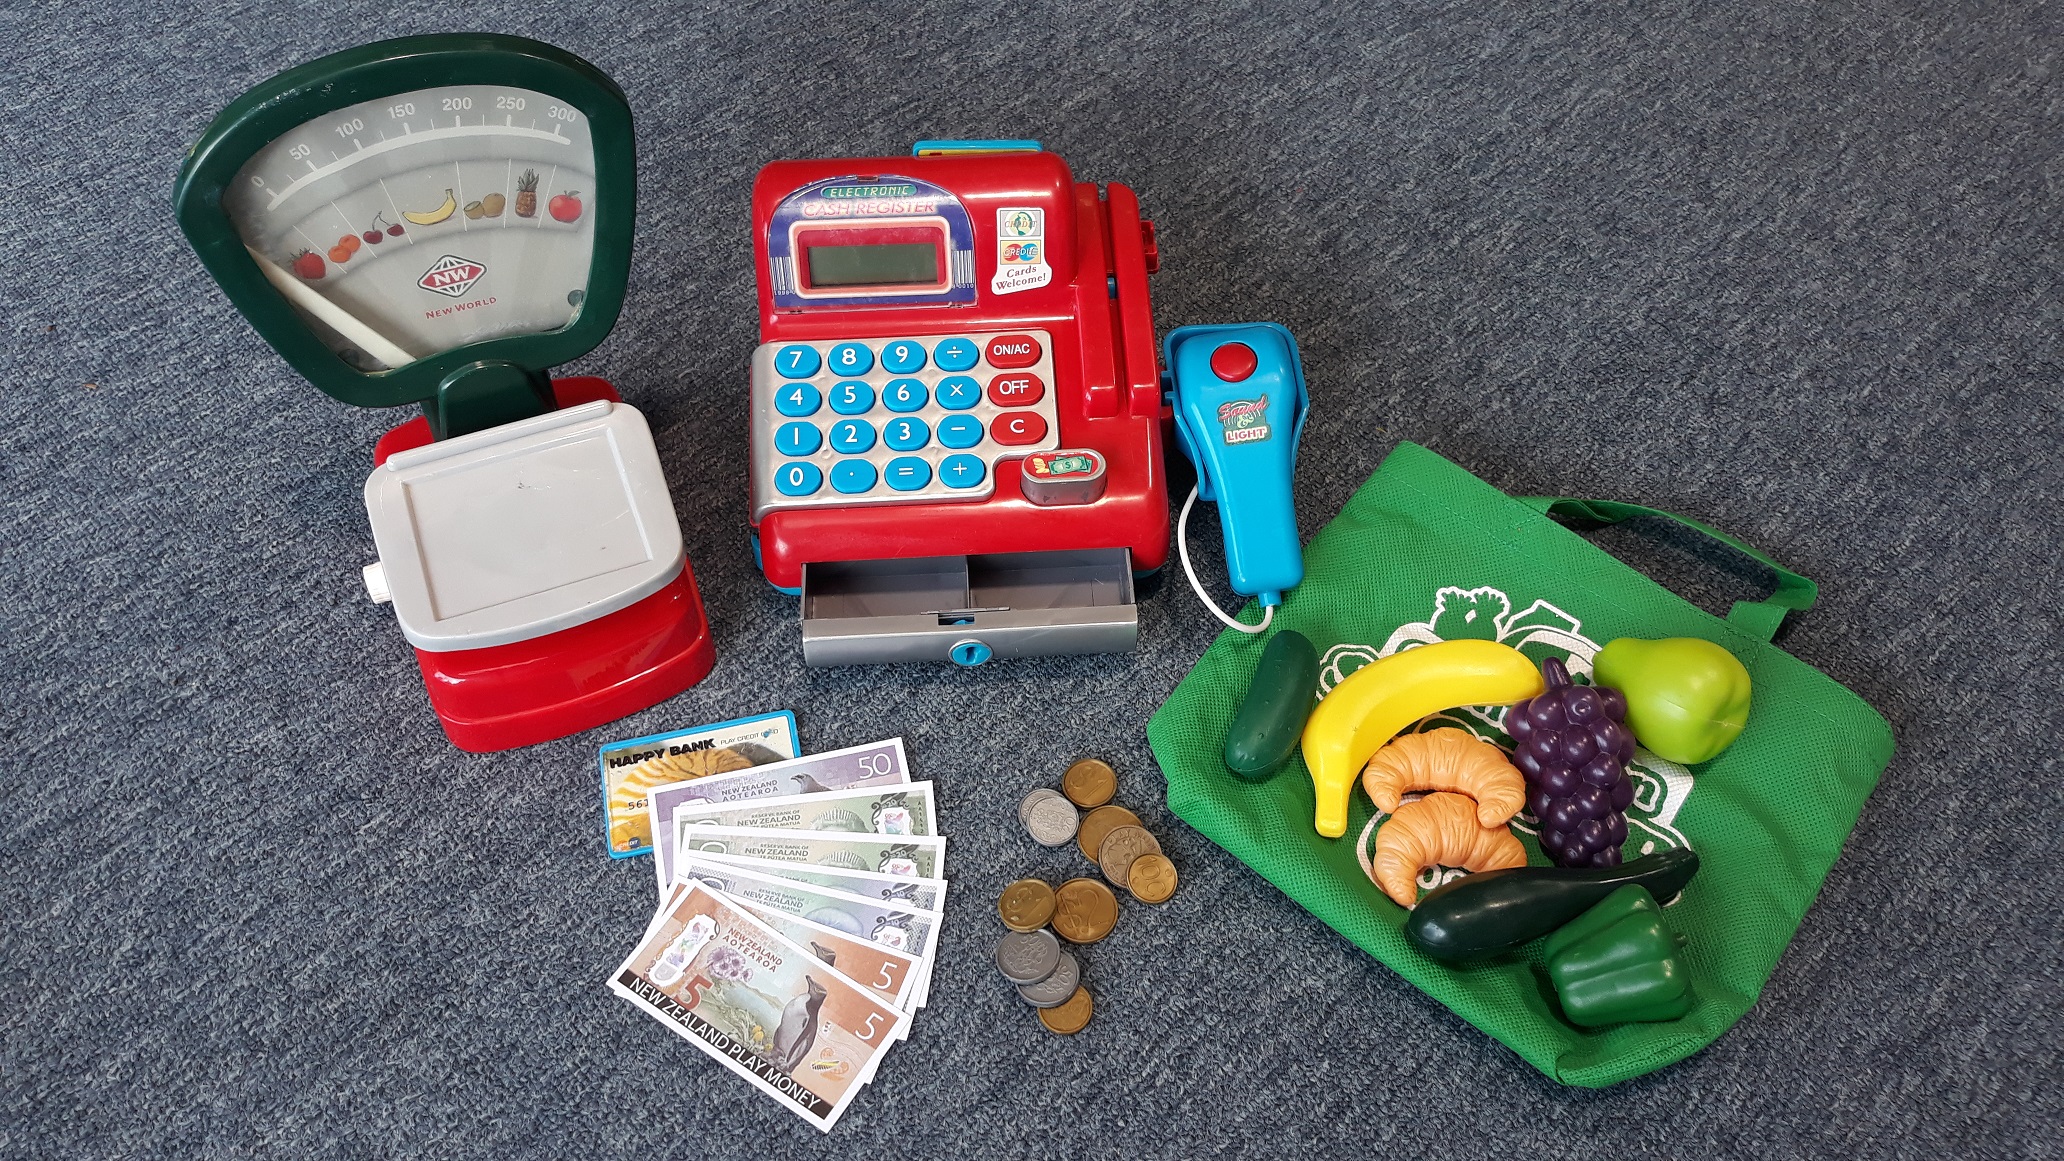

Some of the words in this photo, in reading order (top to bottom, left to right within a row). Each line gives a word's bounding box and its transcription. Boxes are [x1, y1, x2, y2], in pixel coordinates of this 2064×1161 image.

[387, 102, 416, 120] 150
[442, 96, 473, 112] 200
[496, 96, 526, 111] 250
[547, 105, 576, 123] 300
[334, 118, 365, 139] 100
[288, 143, 312, 162] 50
[251, 175, 265, 188] 0
[830, 185, 911, 198] ELECTRONIC
[804, 202, 850, 217] CASH
[856, 200, 936, 215] REGISTER
[433, 266, 472, 288] NW
[1006, 265, 1037, 278] Cards
[996, 272, 1046, 291] Welcome!
[425, 305, 453, 320] NEW
[454, 296, 497, 314] WORLD
[842, 348, 857, 366] 8
[895, 346, 908, 364] 9
[993, 343, 1030, 356] ON/AC
[789, 351, 803, 369] 7
[789, 388, 804, 406] 4
[843, 387, 856, 403] 5
[897, 384, 910, 401] 6
[1000, 381, 1029, 395] OFF
[844, 426, 858, 443] 2
[899, 423, 911, 440] 3
[1010, 420, 1025, 434] C
[1226, 427, 1266, 442] LIGHT
[794, 428, 800, 445] 1
[790, 468, 804, 487] 0
[609, 749, 665, 769] HAPPY
[669, 738, 717, 757] BANK
[720, 737, 736, 745] PLAY
[858, 753, 892, 780] 50
[721, 784, 741, 797] NEW
[741, 779, 779, 793] ZEALAND
[722, 786, 779, 802] AOTEAROA
[737, 819, 758, 827] NEW
[760, 814, 801, 825] ZEALAND
[745, 847, 766, 855] NEW
[767, 848, 809, 857] ZEALAND
[743, 890, 764, 899] NEW
[764, 894, 804, 909] ZEALAND
[722, 935, 777, 973] AOTEAROA
[728, 927, 749, 945] NEW
[747, 940, 783, 966] ZEALAND
[872, 961, 898, 990] 5
[674, 974, 713, 1010] 5
[855, 1012, 885, 1040] 5
[630, 977, 665, 1009] NEW
[662, 1000, 729, 1050] ZEALAND
[727, 1043, 766, 1074] PLAY
[763, 1070, 821, 1110] MONEY
